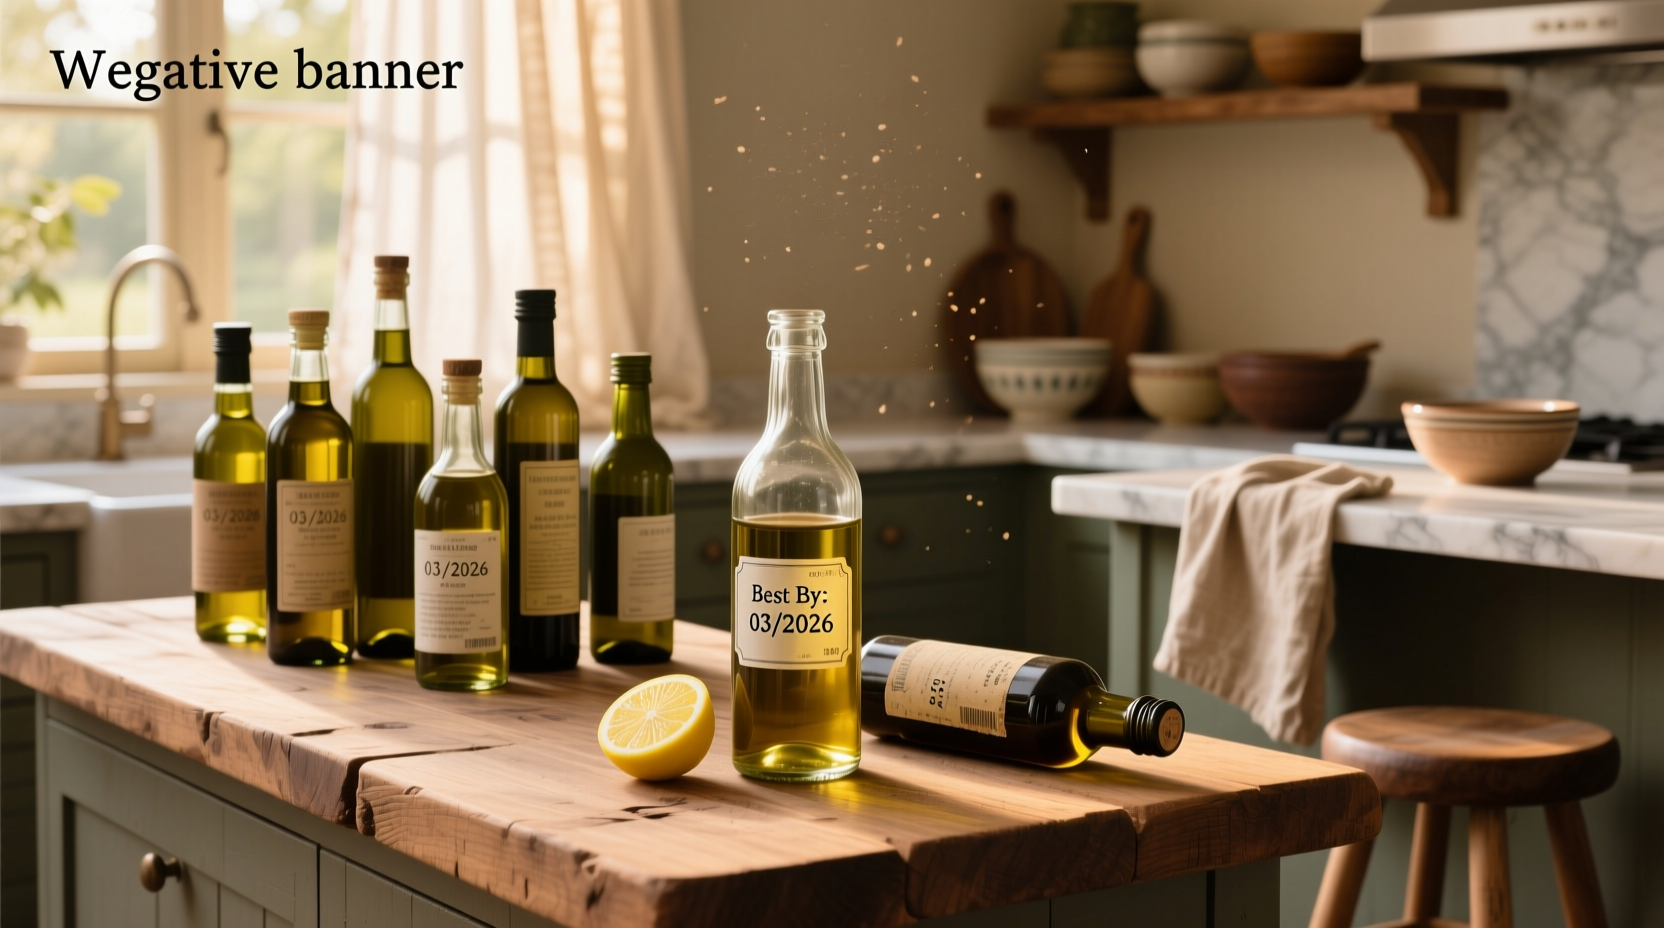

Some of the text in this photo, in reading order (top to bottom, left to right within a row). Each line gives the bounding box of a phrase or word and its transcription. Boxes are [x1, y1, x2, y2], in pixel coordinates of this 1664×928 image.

[203, 508, 261, 525] 03/2026
[289, 509, 347, 527] 03/2026
[424, 560, 489, 579] 03/2026
[751, 584, 828, 609] Best By:
[749, 612, 834, 638] 03/2026
